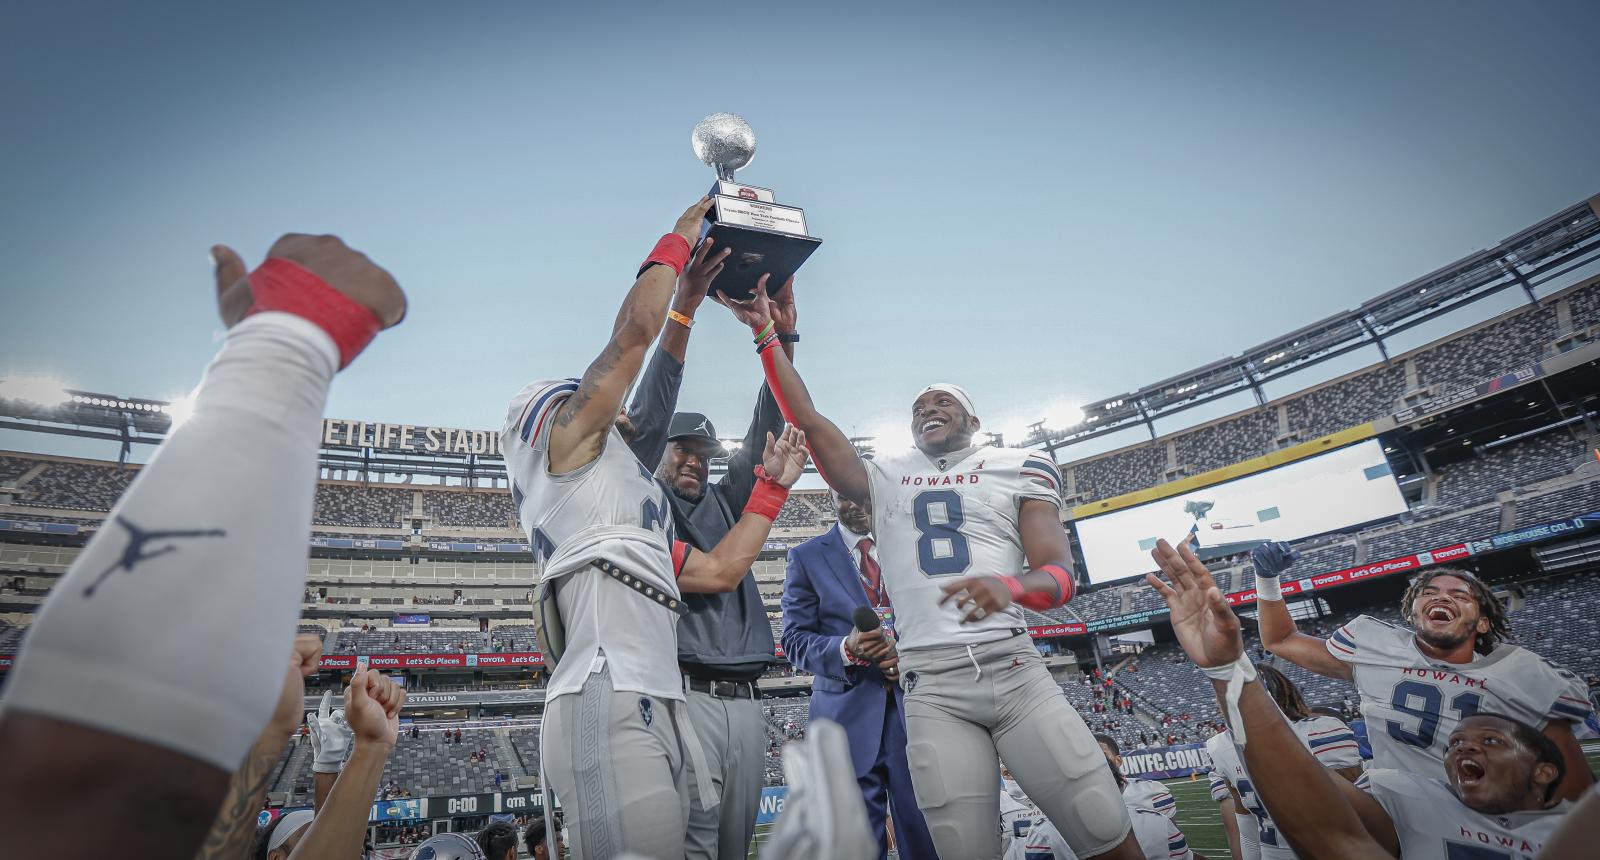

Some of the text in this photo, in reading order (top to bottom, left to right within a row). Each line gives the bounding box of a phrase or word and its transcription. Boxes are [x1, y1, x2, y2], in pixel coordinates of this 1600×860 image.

[320, 418, 503, 455] ETLIFE STADI
[901, 473, 980, 486] HOWARD
[911, 487, 973, 579] 8
[1492, 526, 1551, 546] MOREHOUSE
[1550, 522, 1574, 533] COL.
[1433, 546, 1468, 559] TOYOTA
[1312, 560, 1412, 586] TOYOTA Let's Go Places
[1086, 620, 1106, 628] THANKS
[1153, 607, 1171, 615] COMIN
[324, 658, 350, 666] Places
[423, 657, 436, 665] Go
[436, 657, 460, 665] Places
[448, 796, 478, 814] 0:00
[506, 793, 545, 809] QTR 4T
[760, 796, 784, 814] Wa
[1017, 810, 1045, 819] HOWAR
[1460, 826, 1542, 853] HOWA
